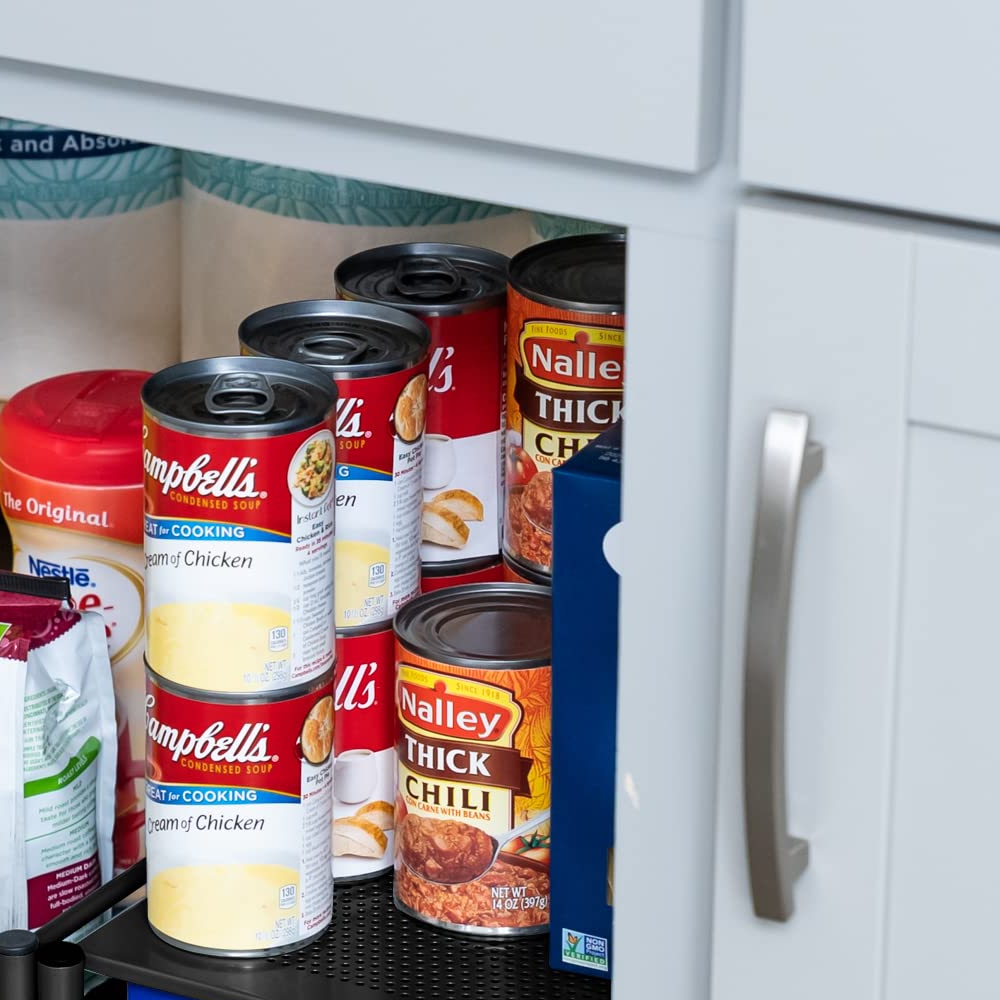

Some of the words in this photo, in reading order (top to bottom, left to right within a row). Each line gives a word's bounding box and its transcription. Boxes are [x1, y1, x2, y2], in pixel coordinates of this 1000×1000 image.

[10, 134, 53, 153] and
[532, 343, 622, 381] Nalle
[339, 440, 366, 449] SOUP
[144, 448, 261, 498] ampbell's
[3, 491, 22, 511] The
[26, 497, 109, 528] Original
[169, 491, 229, 511] CONDENSED
[233, 500, 261, 511] SOUP
[145, 521, 158, 535] EAT
[159, 525, 170, 536] for
[171, 524, 245, 539] COOKING
[170, 553, 182, 568] of
[184, 549, 253, 569] Chicken
[372, 565, 384, 576] 130
[271, 629, 286, 640] 130
[402, 686, 502, 739] Nalley
[405, 733, 492, 777] THICK
[181, 758, 241, 775] CONDENSED
[246, 763, 273, 774] SOUP
[168, 791, 180, 801] for
[182, 790, 258, 802] COOKING
[405, 775, 490, 812] CHILI
[418, 802, 440, 815] CARNE
[441, 807, 462, 818] WITH
[463, 810, 491, 823] BEANS
[181, 816, 193, 832] of
[195, 814, 265, 831] Chicken
[281, 886, 295, 898] 130
[491, 887, 510, 899] NET
[511, 886, 527, 898] WT
[492, 899, 503, 910] 14
[505, 899, 518, 910] OZ
[520, 895, 548, 911] (397g)
[586, 937, 605, 947] NON
[586, 944, 605, 953] GMO
[564, 950, 606, 965] VERIFIED
